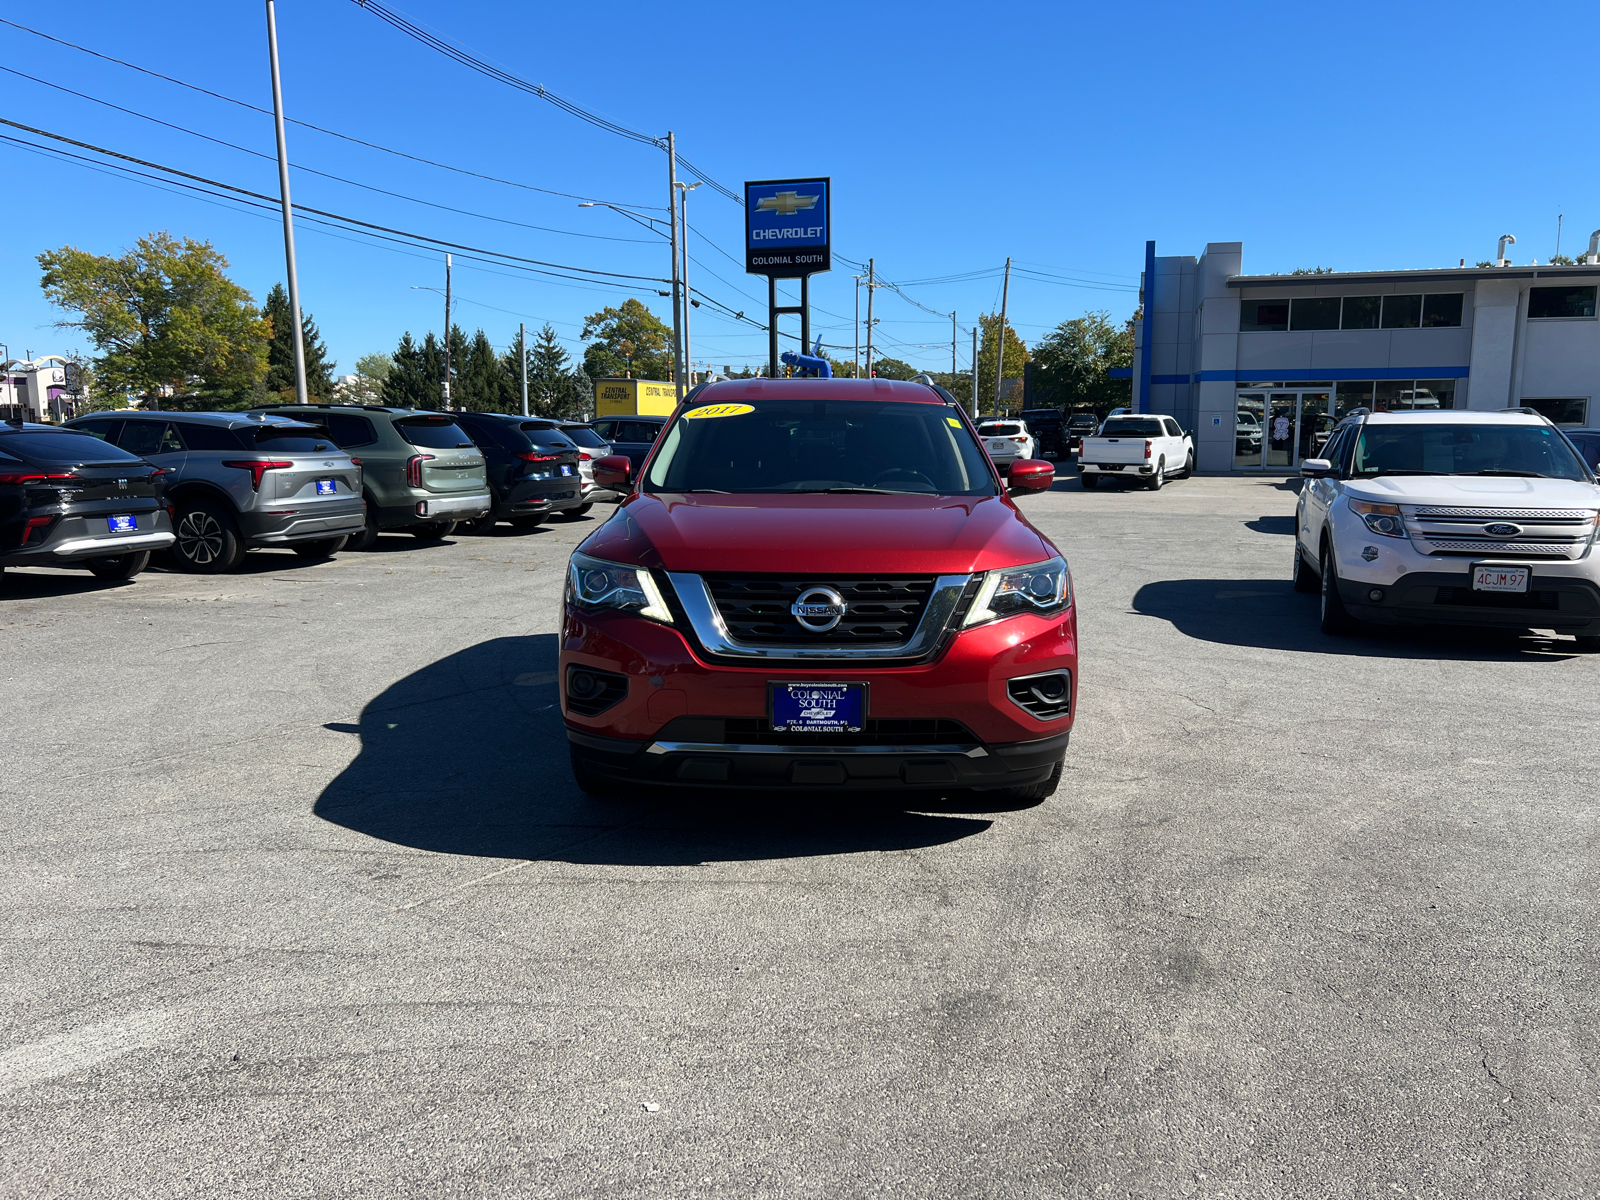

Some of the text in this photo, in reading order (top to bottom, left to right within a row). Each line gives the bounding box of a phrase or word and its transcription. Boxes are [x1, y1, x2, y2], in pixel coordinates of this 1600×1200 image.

[753, 227, 821, 240] CHEVROLET
[752, 255, 823, 265] COLONIAL SOUTH
[604, 386, 627, 394] CENTRAL
[645, 386, 661, 397] CENTRAL
[693, 405, 743, 417] 2017
[1491, 524, 1514, 534] Ford
[1477, 573, 1525, 586] 4CJM 97
[797, 606, 840, 616] NISSAN
[790, 690, 845, 700] COLONIAL
[798, 699, 836, 708] SOUTH
